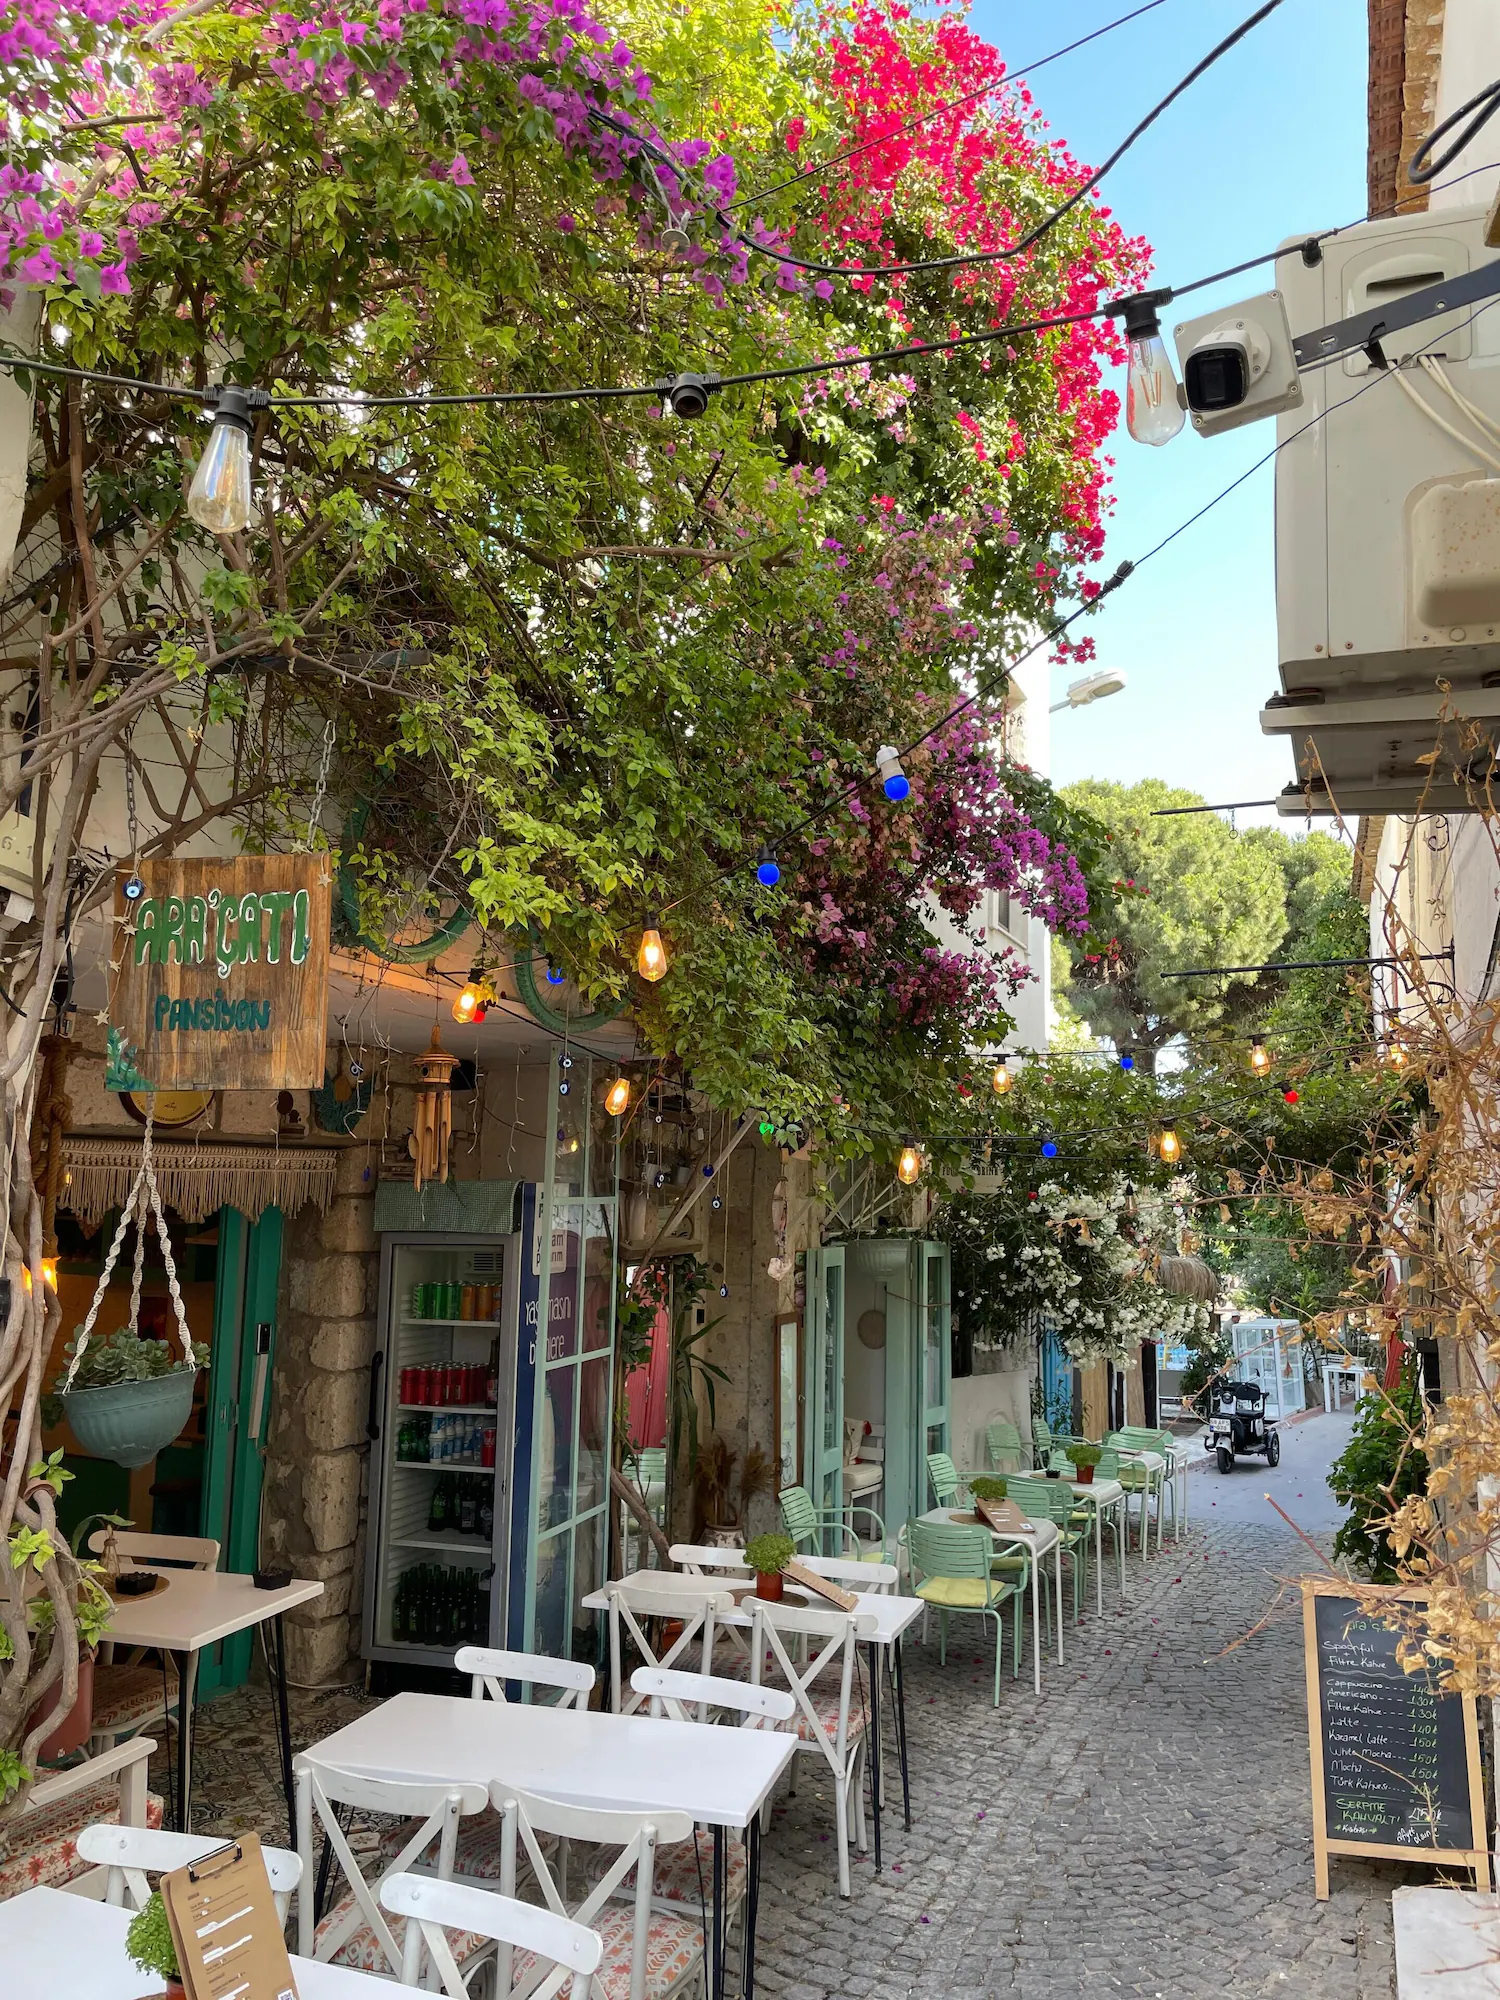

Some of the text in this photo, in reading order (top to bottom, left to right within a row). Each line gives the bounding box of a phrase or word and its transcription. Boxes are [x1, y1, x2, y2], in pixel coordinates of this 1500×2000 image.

[1322, 1641, 1375, 1656] Spoonful
[1328, 1655, 1358, 1667] Filtre
[1326, 1678, 1383, 1690] Cappuccino
[1326, 1687, 1378, 1700] Americano
[1326, 1699, 1352, 1712] Filtre
[1328, 1729, 1363, 1743] Karamel
[1331, 1760, 1362, 1773] Mocha
[1336, 1798, 1387, 1813] SERPME
